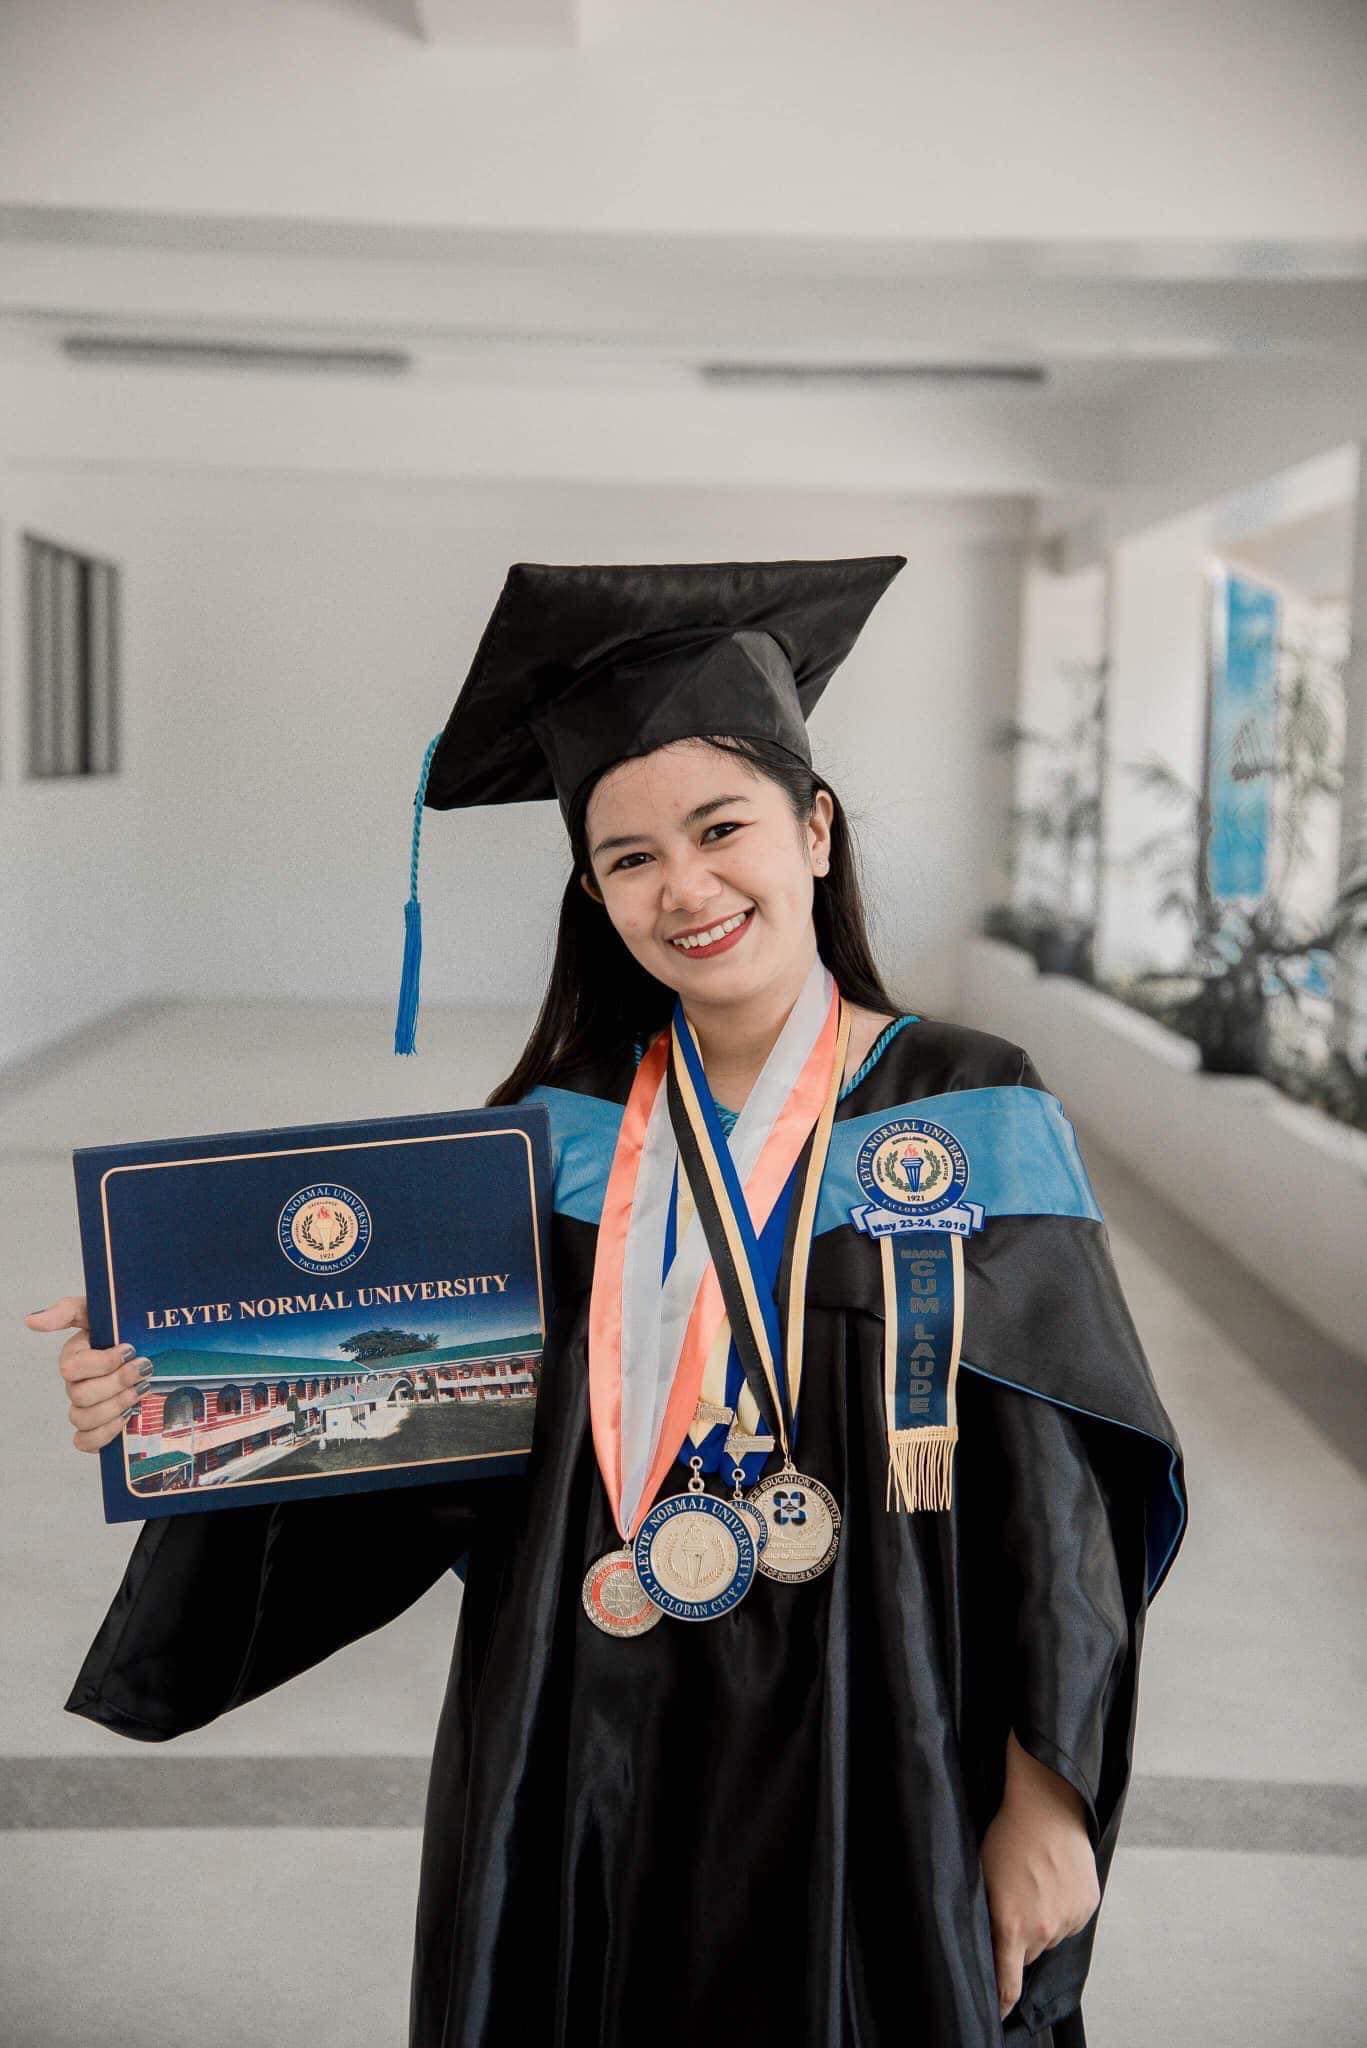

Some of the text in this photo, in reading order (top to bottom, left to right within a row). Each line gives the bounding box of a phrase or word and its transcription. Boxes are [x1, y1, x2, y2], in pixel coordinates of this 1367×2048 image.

[867, 1121, 919, 1150] NORMAL
[923, 1123, 967, 1187] UNIVERSITY
[860, 1150, 875, 1189] LEYTE
[287, 1187, 330, 1212] NORMAL
[333, 1187, 369, 1243] UNIVERSITY
[281, 1214, 294, 1250] LEYTE
[872, 1219, 967, 1232] May 23-24, 2019
[298, 1251, 357, 1272] TACLOBAN CITY
[146, 1273, 512, 1330] LEYTE NORMAL UNIVERSITY
[909, 1260, 940, 1414] CUM LAUDE
[762, 1475, 841, 1529] EDUCATION INSTITUTE
[637, 1498, 752, 1582] LEYTE NORMAL UNIVERSITY
[649, 1583, 709, 1617] TACLOBAN
[711, 1587, 739, 1612] CITY
